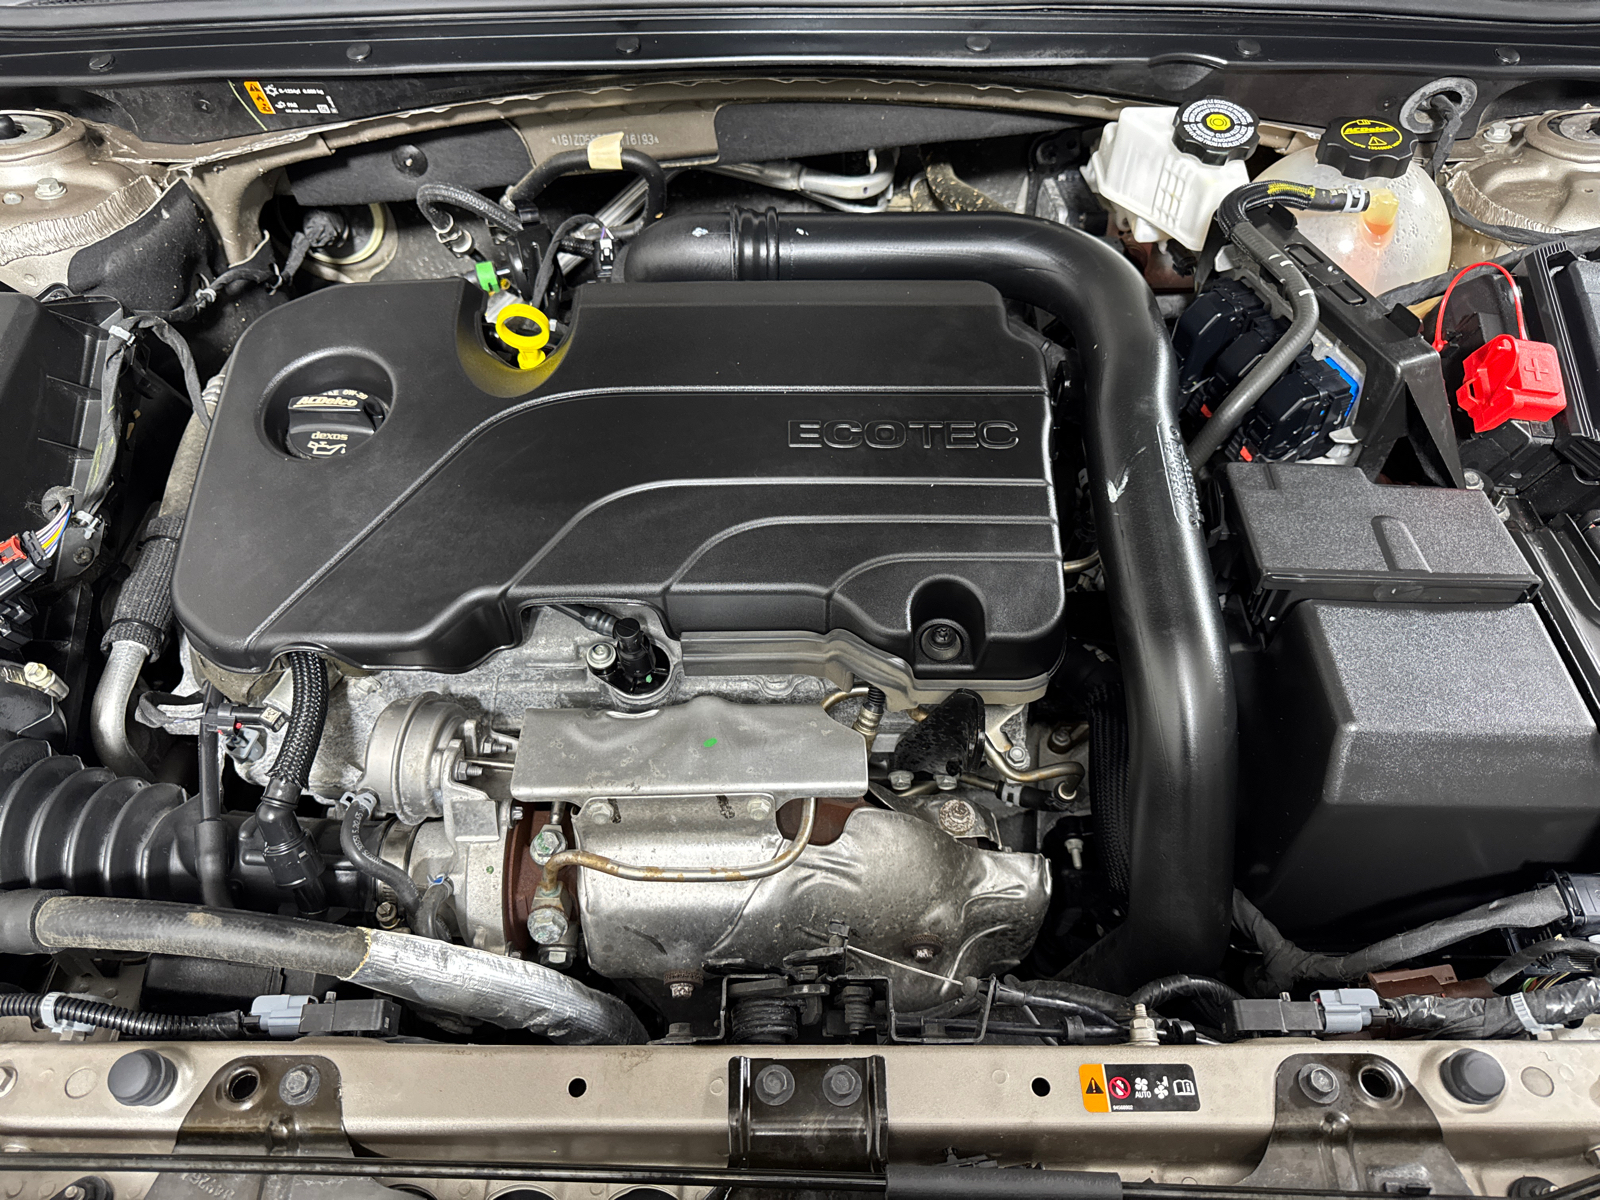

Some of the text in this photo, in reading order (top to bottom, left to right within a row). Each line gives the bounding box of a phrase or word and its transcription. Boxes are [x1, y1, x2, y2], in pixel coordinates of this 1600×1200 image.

[294, 396, 358, 406] ACDelco
[311, 431, 349, 441] dexos
[787, 419, 1020, 450] ECOTEC
[1134, 1091, 1152, 1099] AUTO
